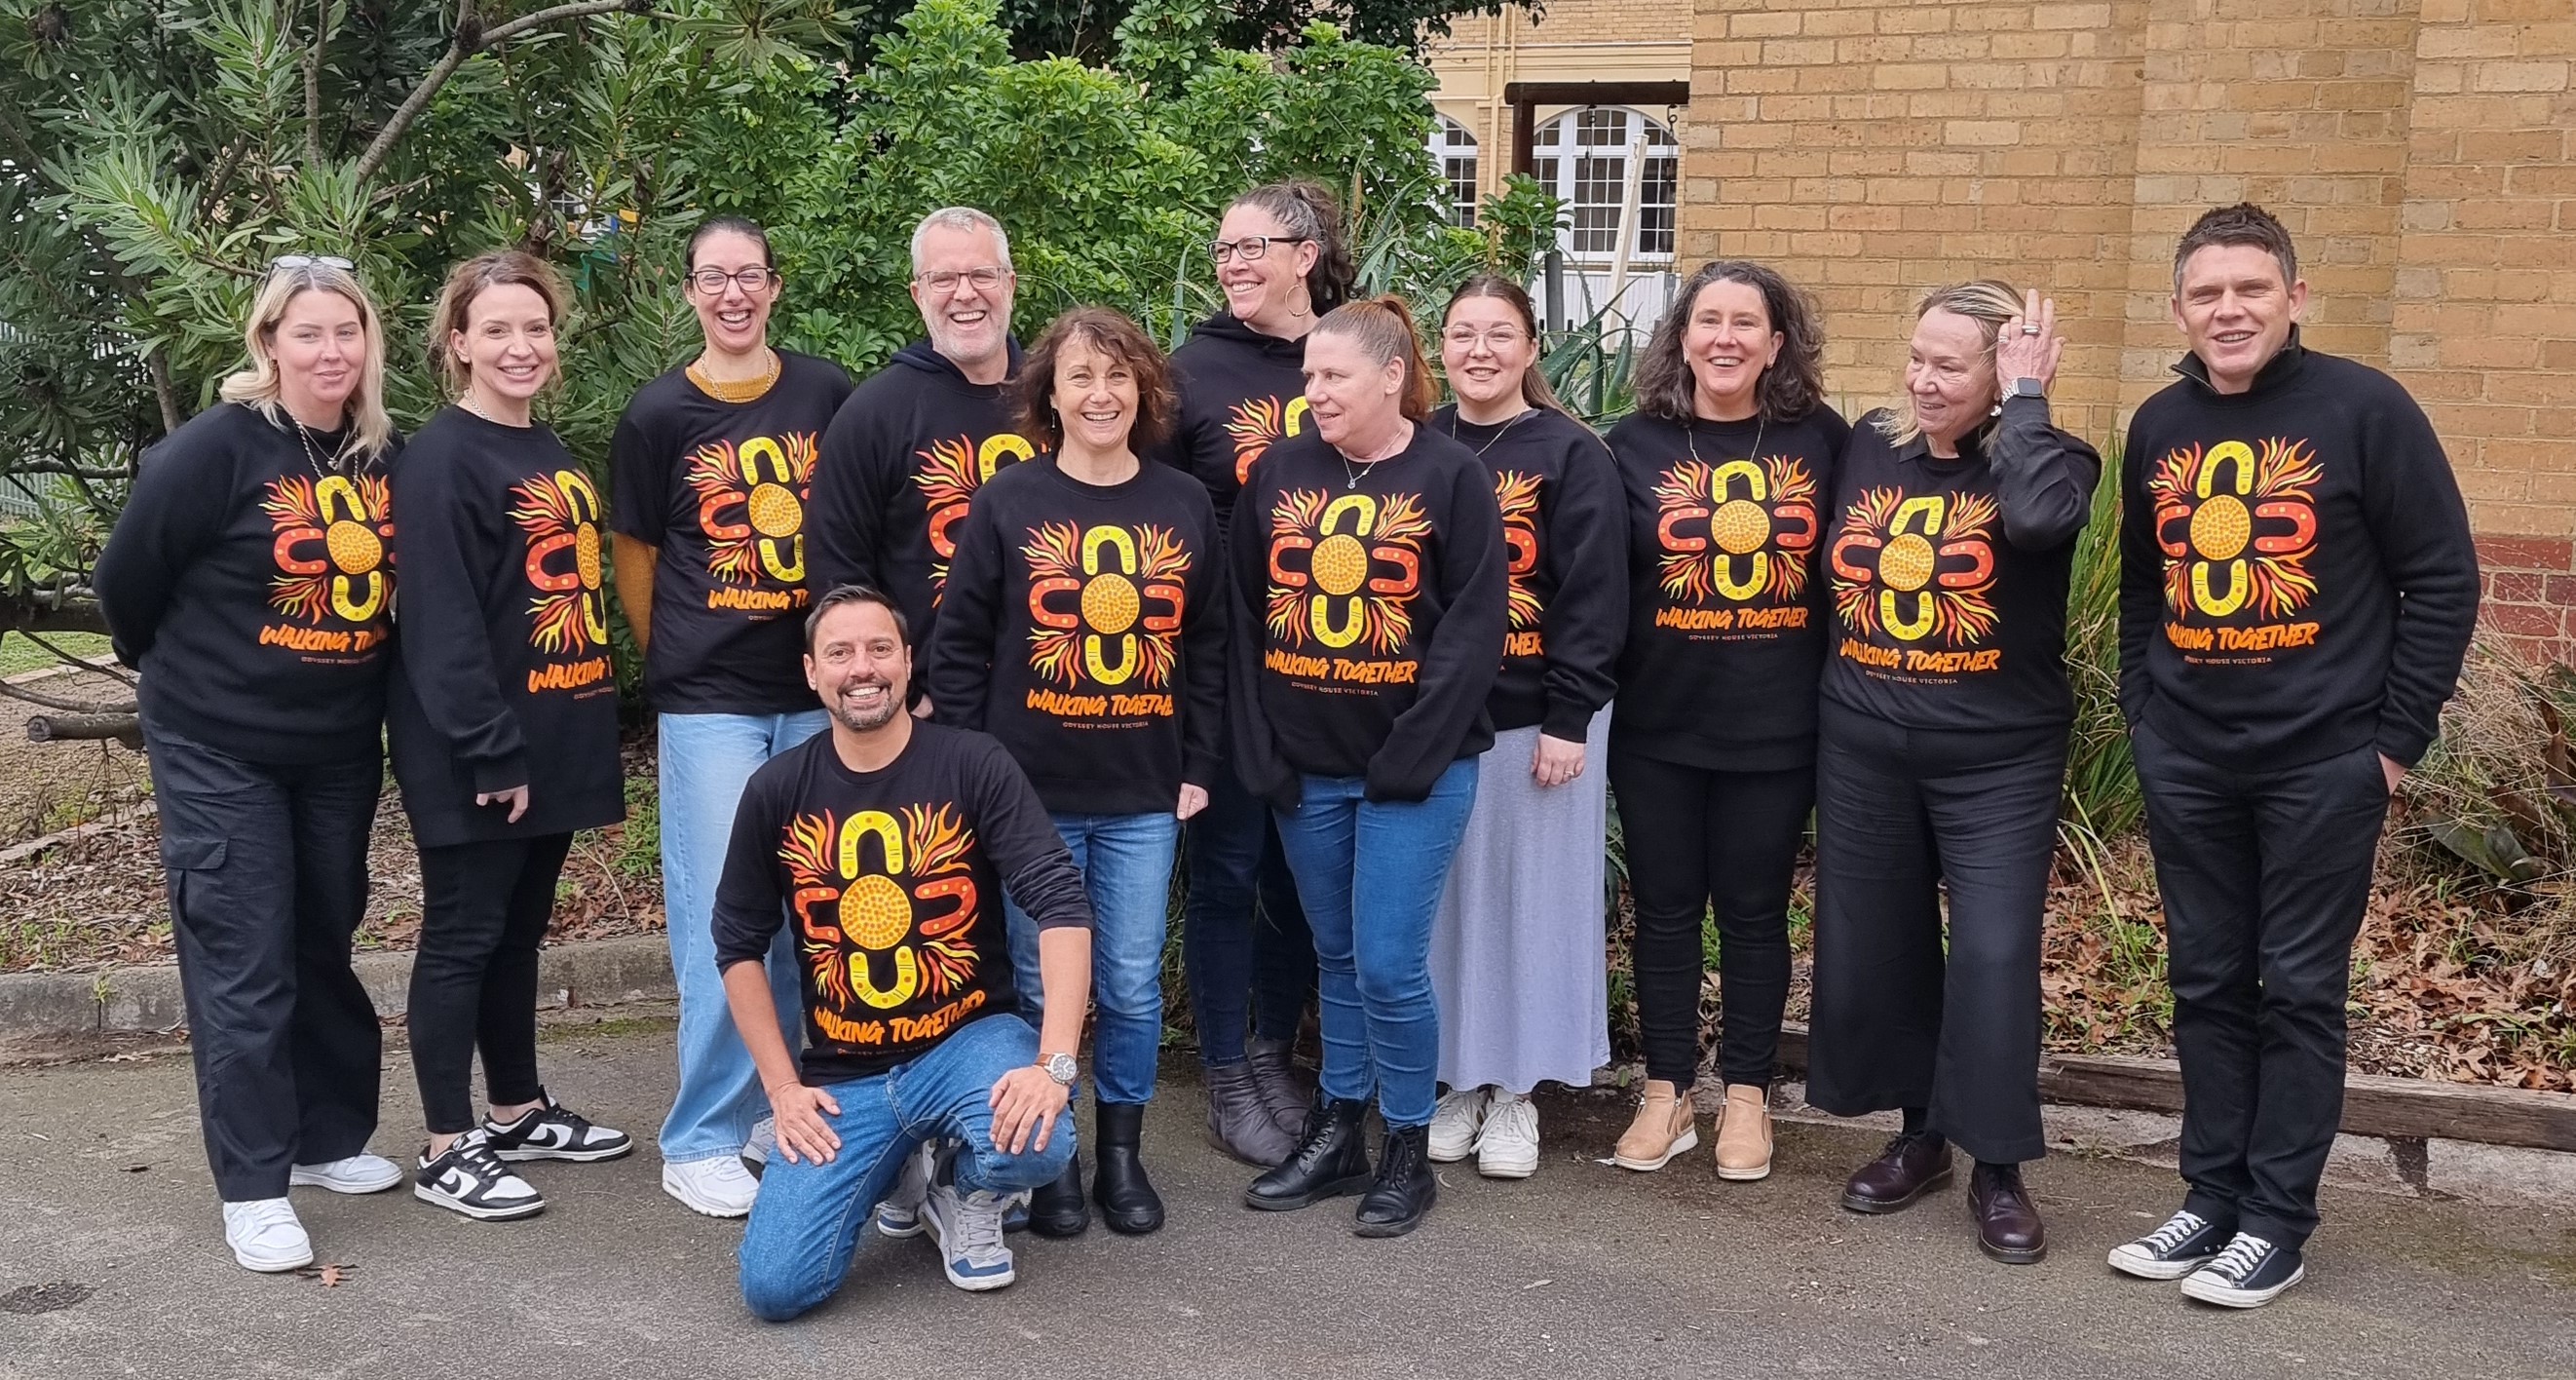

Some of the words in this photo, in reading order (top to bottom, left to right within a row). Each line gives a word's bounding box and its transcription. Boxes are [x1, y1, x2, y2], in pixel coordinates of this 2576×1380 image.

[707, 586, 791, 610] WALKING
[1655, 606, 1734, 631] WALKING
[1737, 606, 1809, 630] TOGETHER
[258, 624, 352, 653] WALKING
[2216, 622, 2321, 651] TOGETHER
[1265, 647, 1331, 680] WALKING
[1333, 658, 1420, 684] TOGETHER
[1838, 637, 1903, 670] WALKING
[1906, 649, 2001, 673] TOGETHER
[527, 656, 606, 694] WALKING
[1026, 688, 1109, 717] WALKING
[1062, 721, 1095, 730] ODYSSEY
[814, 1006, 887, 1046] WALKING
